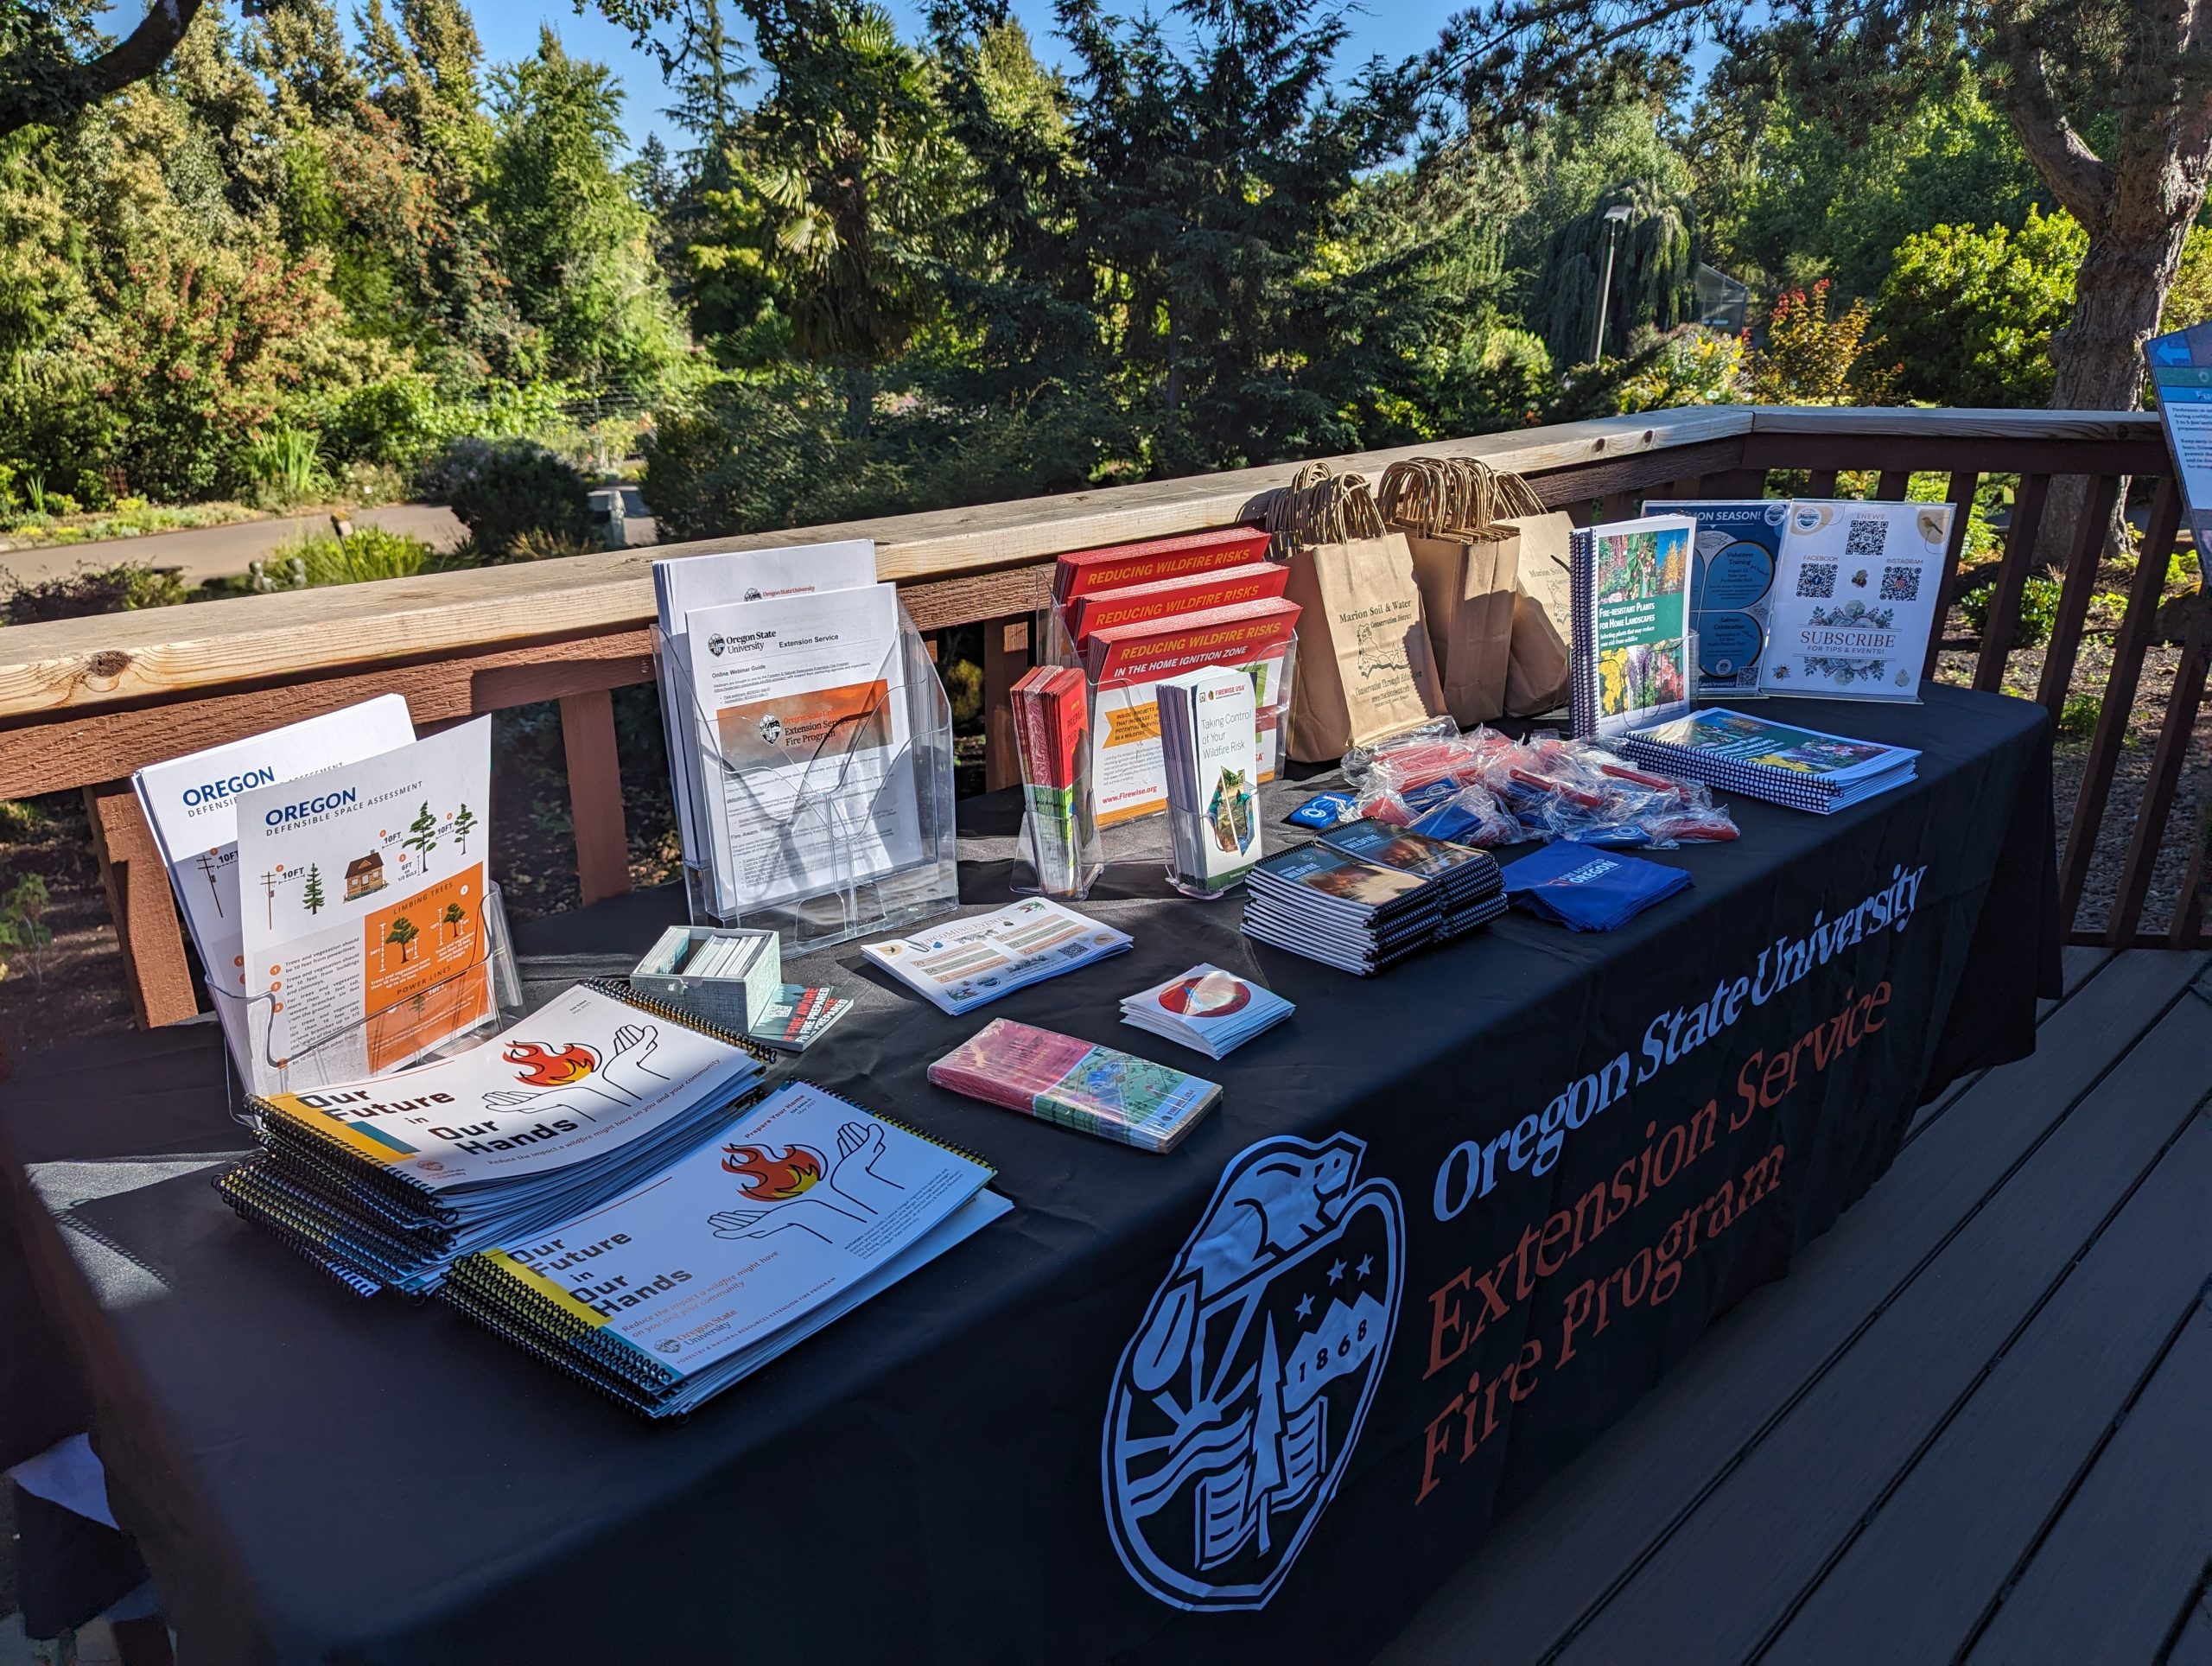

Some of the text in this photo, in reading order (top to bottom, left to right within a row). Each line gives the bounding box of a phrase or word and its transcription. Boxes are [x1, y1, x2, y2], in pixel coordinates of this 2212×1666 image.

[1717, 512, 1761, 520] SEASON!
[1088, 549, 1250, 585] REDUCING WILDFIRE RISKS
[1529, 566, 1563, 578] Marion Soil
[792, 586, 815, 595] University
[1096, 585, 1259, 626] REDUCING WILDFIRE RISKS
[1339, 600, 1411, 623] Marion Soil & Water
[1599, 602, 1655, 618] FIRE-RESISTANT PLANTS
[1370, 613, 1412, 628] Conservation District
[1610, 618, 1624, 628] HOME
[1625, 614, 1655, 626] LANDSCAPES
[727, 630, 776, 645] Oregon State
[728, 641, 765, 654] University
[779, 634, 839, 648] Extension Service
[1121, 622, 1281, 660] REDUCING WILDFIRE RISKS
[1801, 631, 1896, 647] SUBSCRIBE
[1114, 645, 1248, 677] IN THE HOME IGNITION ZONE
[1216, 687, 1235, 696] FIREWISE
[1356, 676, 1400, 696] Conservation Through
[784, 715, 806, 724] Oregon
[785, 722, 822, 735] Extension
[1116, 724, 1139, 734] POTENTIAL
[1201, 717, 1224, 729] Taking
[1225, 709, 1251, 723] Control
[785, 731, 836, 746] Fire Program
[1203, 732, 1225, 744] of Your
[1203, 740, 1245, 759] Wildfire Risk
[183, 766, 275, 806] OREGON
[1103, 785, 1157, 804] www.Firewise.org
[265, 787, 356, 826] OREGON
[266, 781, 423, 836] DEFENSIBLE SPACE ASSESSMENT
[384, 831, 402, 843] 10FT
[438, 823, 453, 835] 10FT
[1345, 835, 1381, 850] WILDFIRE
[282, 868, 304, 879] 10FT
[1282, 862, 1321, 880] WILDFIRE
[1569, 860, 1620, 883] OREGON
[393, 882, 453, 914] LIMBING TREES
[919, 926, 970, 945] UPCOMING
[970, 916, 1009, 932] EVENTS
[314, 944, 340, 957] vegetation
[342, 937, 359, 946] should
[314, 960, 341, 972] vegetation
[342, 952, 359, 963] should
[337, 961, 359, 971] buildings
[298, 980, 325, 992] chimneys.
[397, 966, 451, 995] POWER LINES
[787, 1017, 805, 1033] FIRE
[797, 988, 819, 1015] AWARE
[799, 988, 830, 1034] FIRE PREPARED
[1433, 862, 1929, 1222] Oregon State University
[296, 1090, 373, 1110] Our
[321, 1091, 455, 1122] Future
[404, 1116, 430, 1125] in
[488, 1155, 516, 1166] Reduce
[531, 1147, 557, 1159] impact
[565, 1134, 593, 1148] wildfire
[594, 1124, 615, 1139] might
[616, 1115, 632, 1127] have
[643, 1103, 656, 1114] you
[657, 1092, 670, 1104] and
[670, 1084, 685, 1097] your
[685, 1059, 721, 1084] community
[745, 1119, 772, 1138] Prepare
[770, 1108, 786, 1119] Your
[785, 1095, 805, 1109] Home
[428, 1119, 502, 1141] Our
[454, 1118, 579, 1156] Hands
[1422, 980, 1891, 1381] Extension Service
[507, 1238, 565, 1264] Our
[525, 1233, 632, 1278] Future
[569, 1271, 594, 1282] in
[569, 1275, 629, 1303] Our
[589, 1269, 693, 1318] Hands
[622, 1315, 653, 1332] Reduce
[654, 1307, 669, 1319] the
[670, 1294, 700, 1313] impact
[706, 1275, 736, 1294] wildfire
[737, 1262, 760, 1278] might
[760, 1251, 779, 1264] have
[647, 1323, 661, 1332] you
[663, 1313, 679, 1323] and
[681, 1304, 699, 1317] your
[700, 1281, 745, 1306] community
[677, 1309, 738, 1342] Oregon State
[684, 1321, 732, 1346] University
[1414, 1144, 1786, 1507] Fire Program
[1299, 1319, 1368, 1383] 1868
